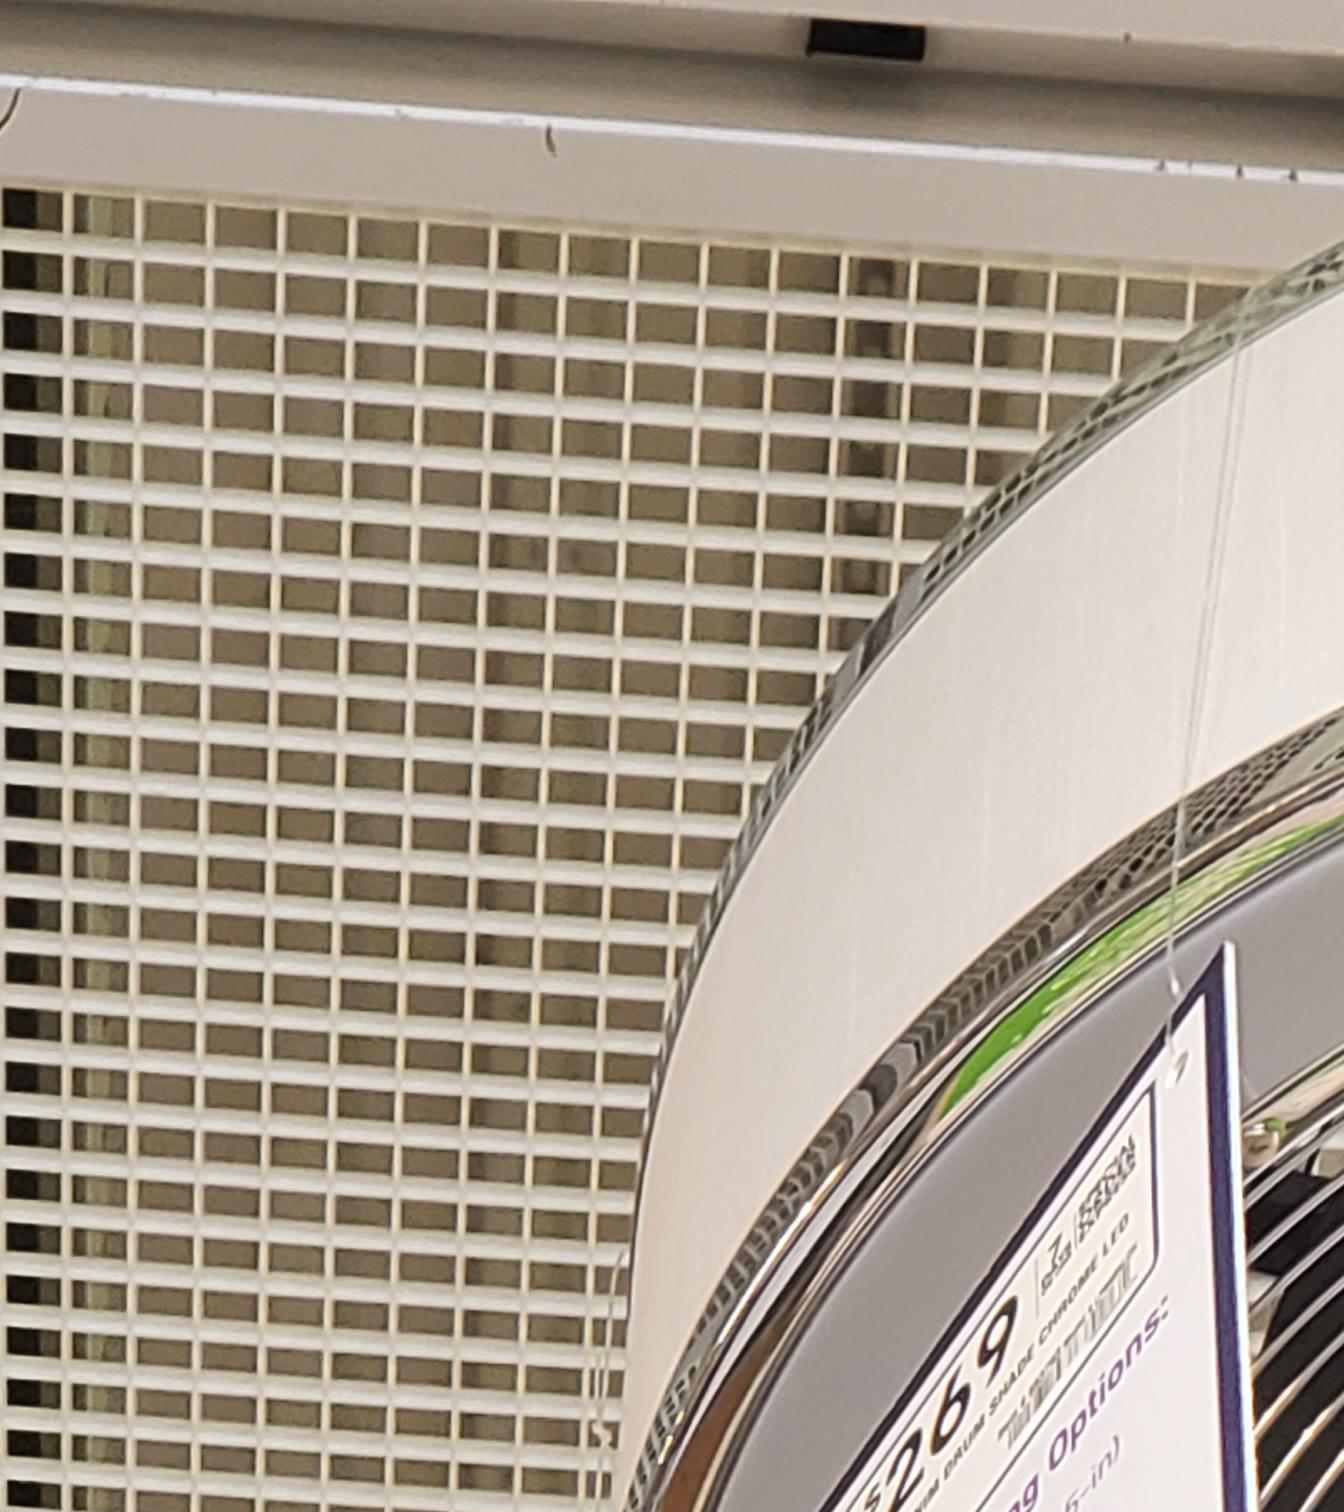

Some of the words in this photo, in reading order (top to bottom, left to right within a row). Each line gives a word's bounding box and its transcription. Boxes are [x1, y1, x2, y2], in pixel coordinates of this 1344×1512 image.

[943, 1414, 986, 1480] DRUM
[989, 1342, 1035, 1417] SHADE
[1039, 1253, 1098, 1346] CHROME
[1048, 1295, 1169, 1471] Options:
